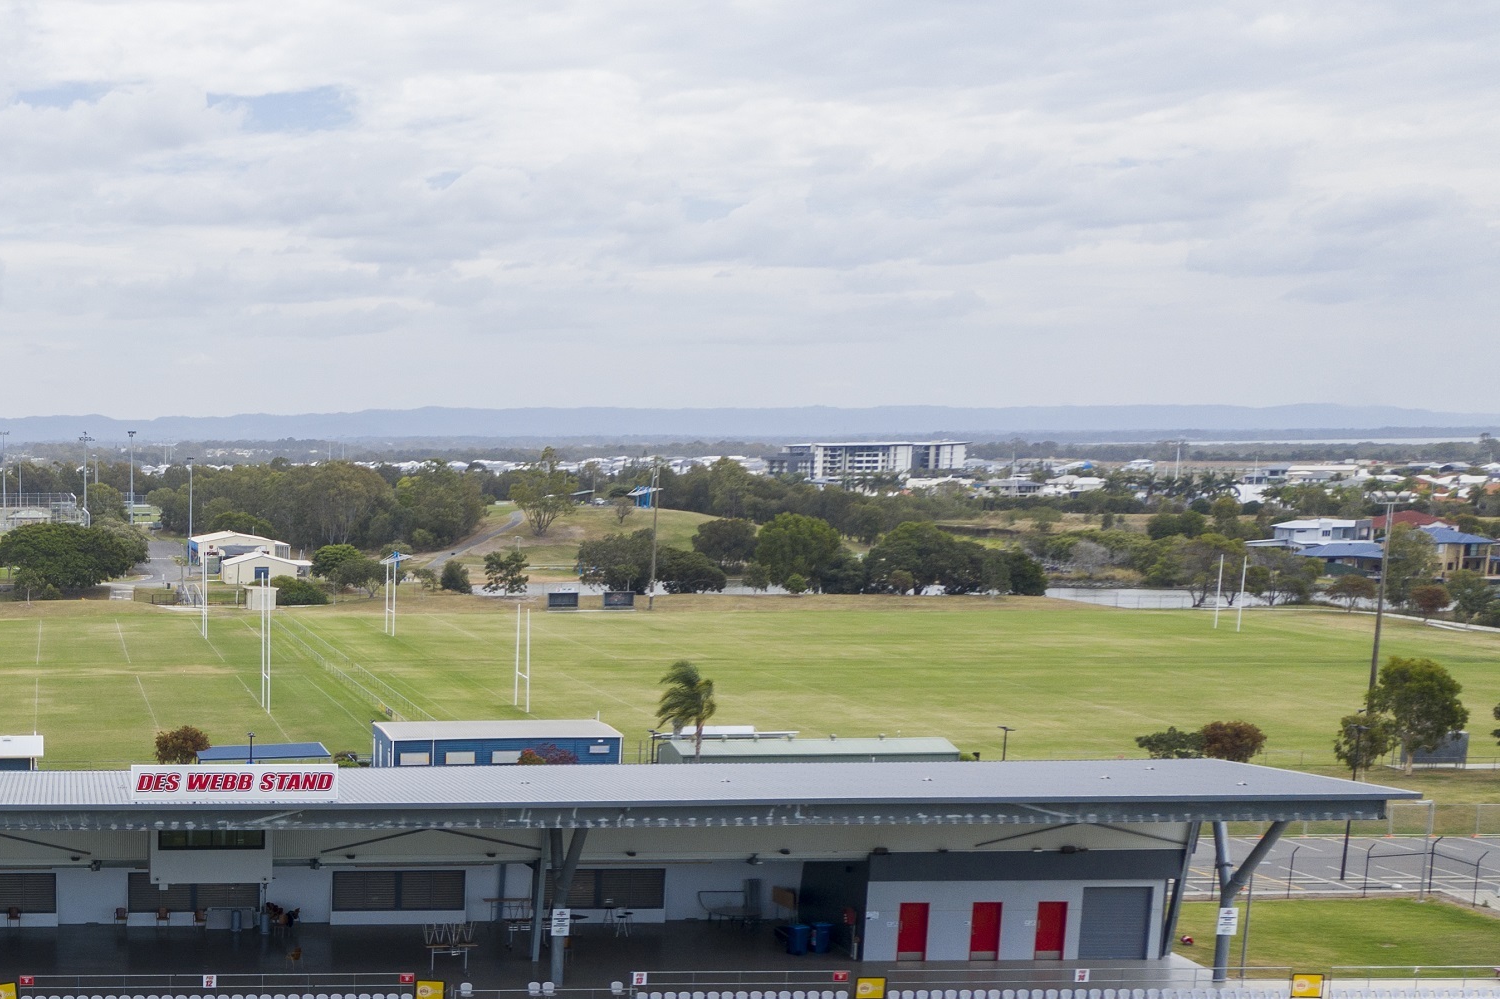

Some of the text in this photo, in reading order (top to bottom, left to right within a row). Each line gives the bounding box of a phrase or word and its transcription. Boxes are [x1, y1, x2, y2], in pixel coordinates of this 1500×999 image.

[136, 771, 335, 792] DES WEBB STAND
